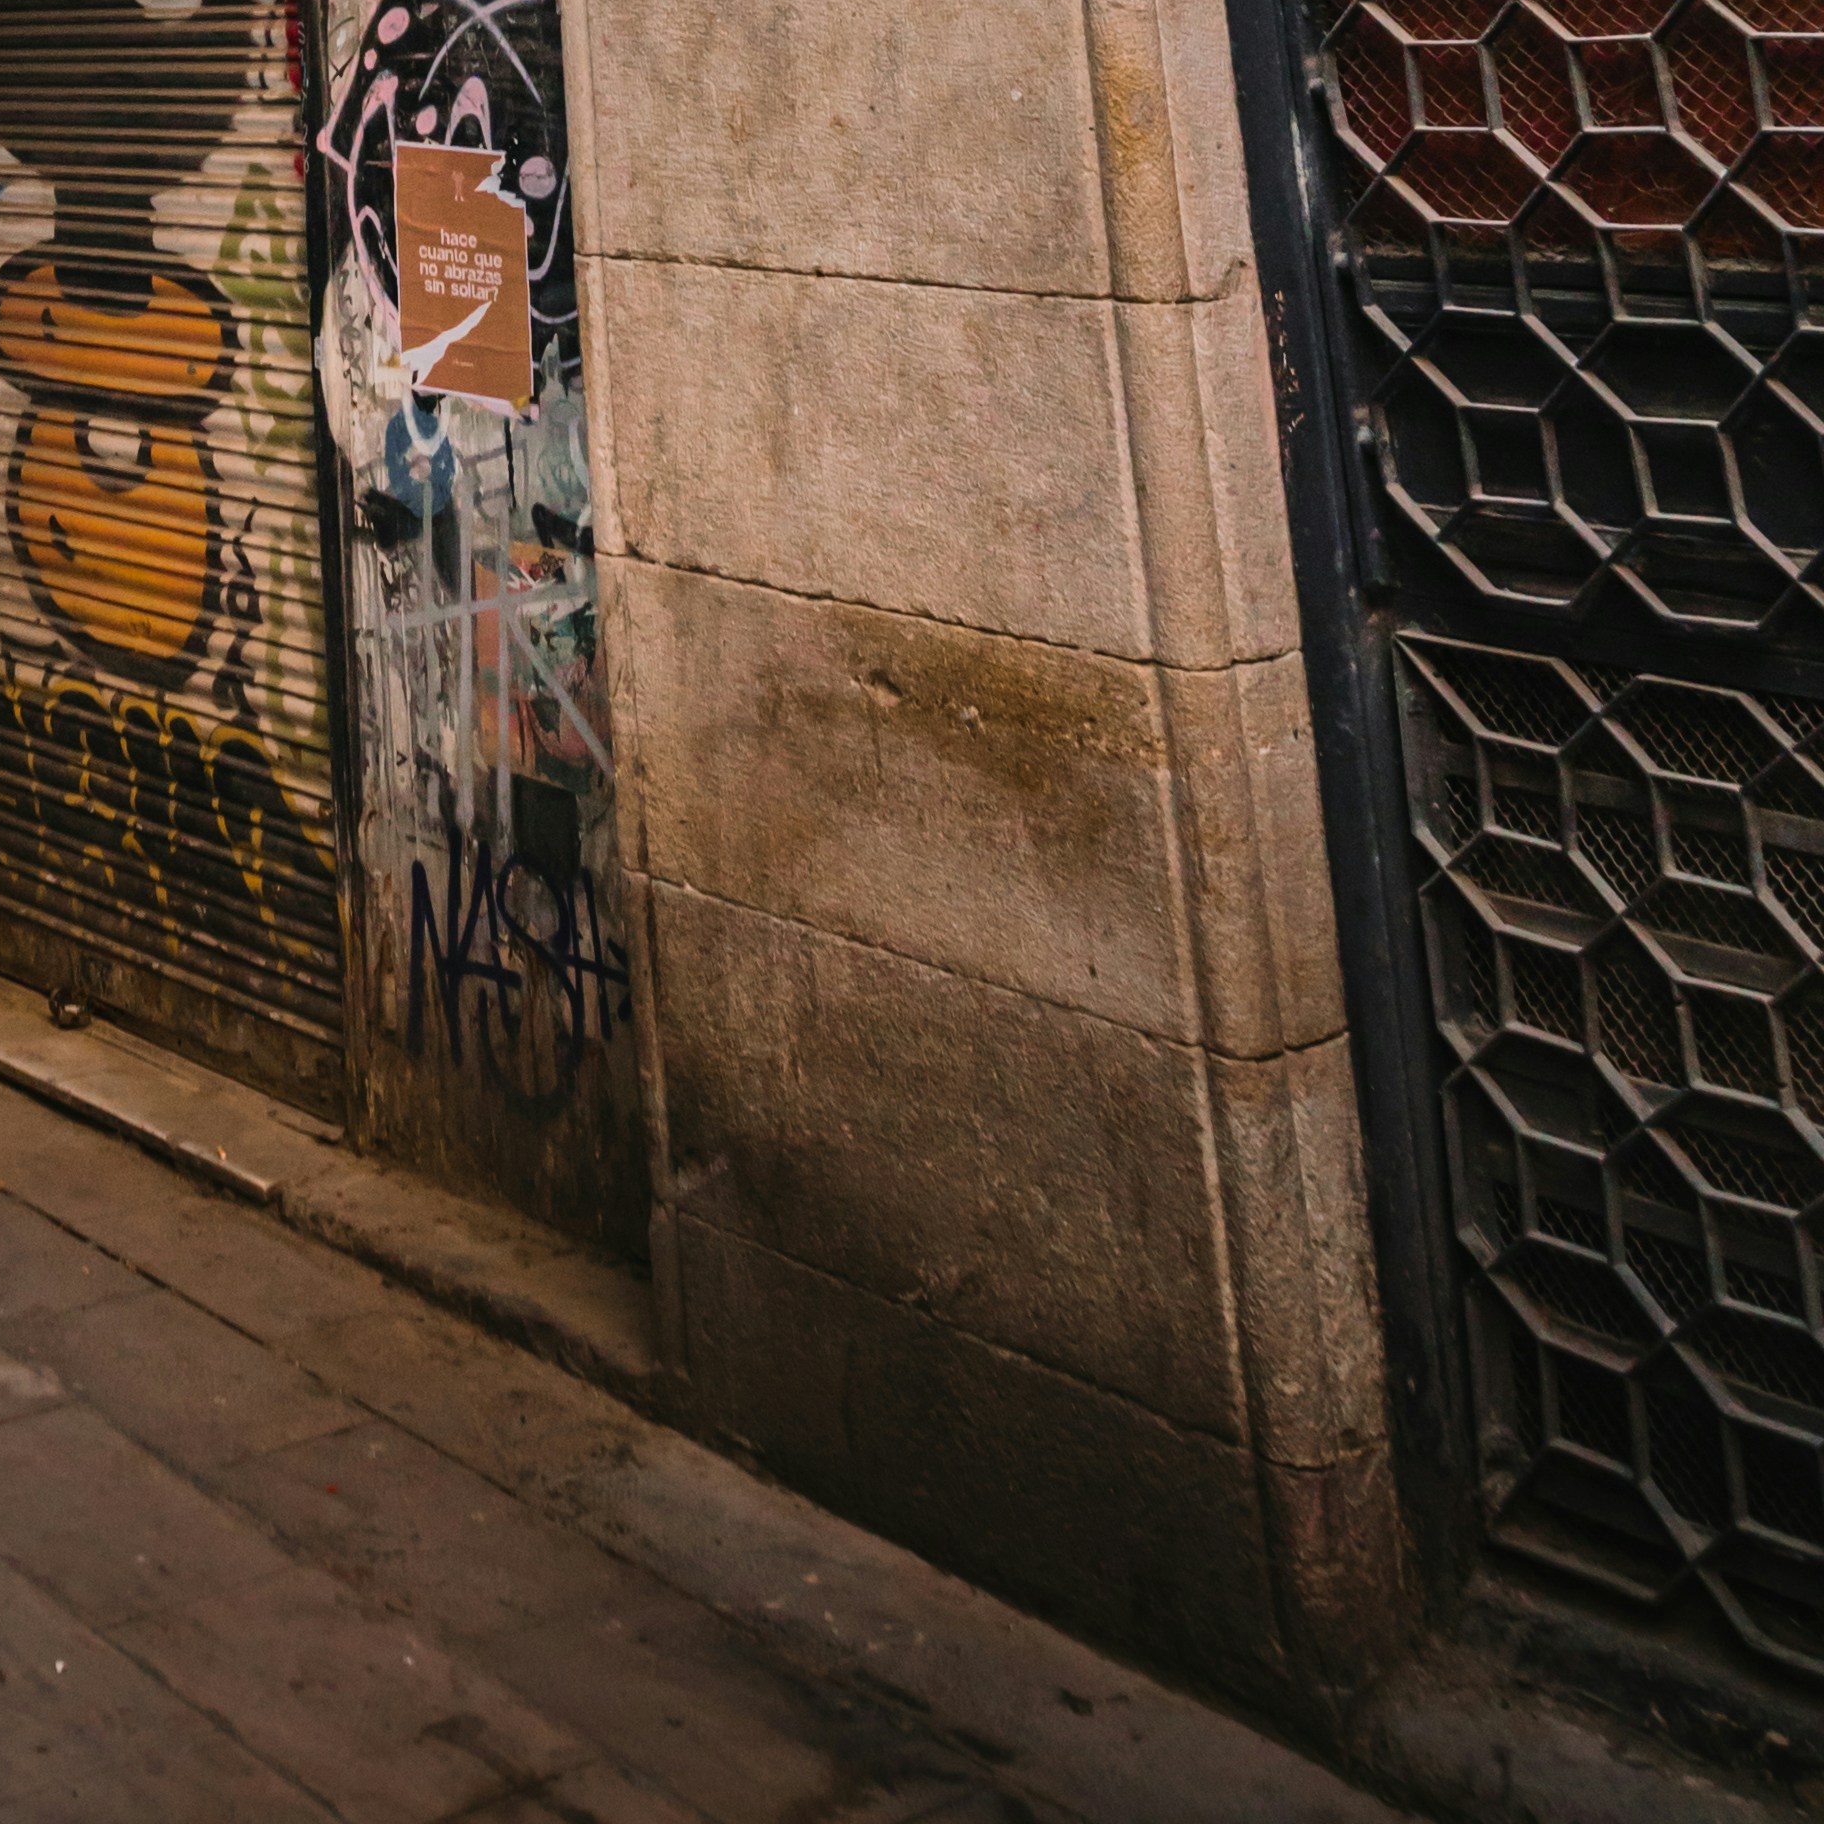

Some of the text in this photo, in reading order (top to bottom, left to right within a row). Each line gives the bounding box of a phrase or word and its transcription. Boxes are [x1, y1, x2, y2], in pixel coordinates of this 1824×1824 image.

[440, 228, 477, 249] hace
[419, 244, 503, 271] cuanto que
[419, 260, 502, 286] no abrazas
[424, 278, 499, 302] sin soltar?
